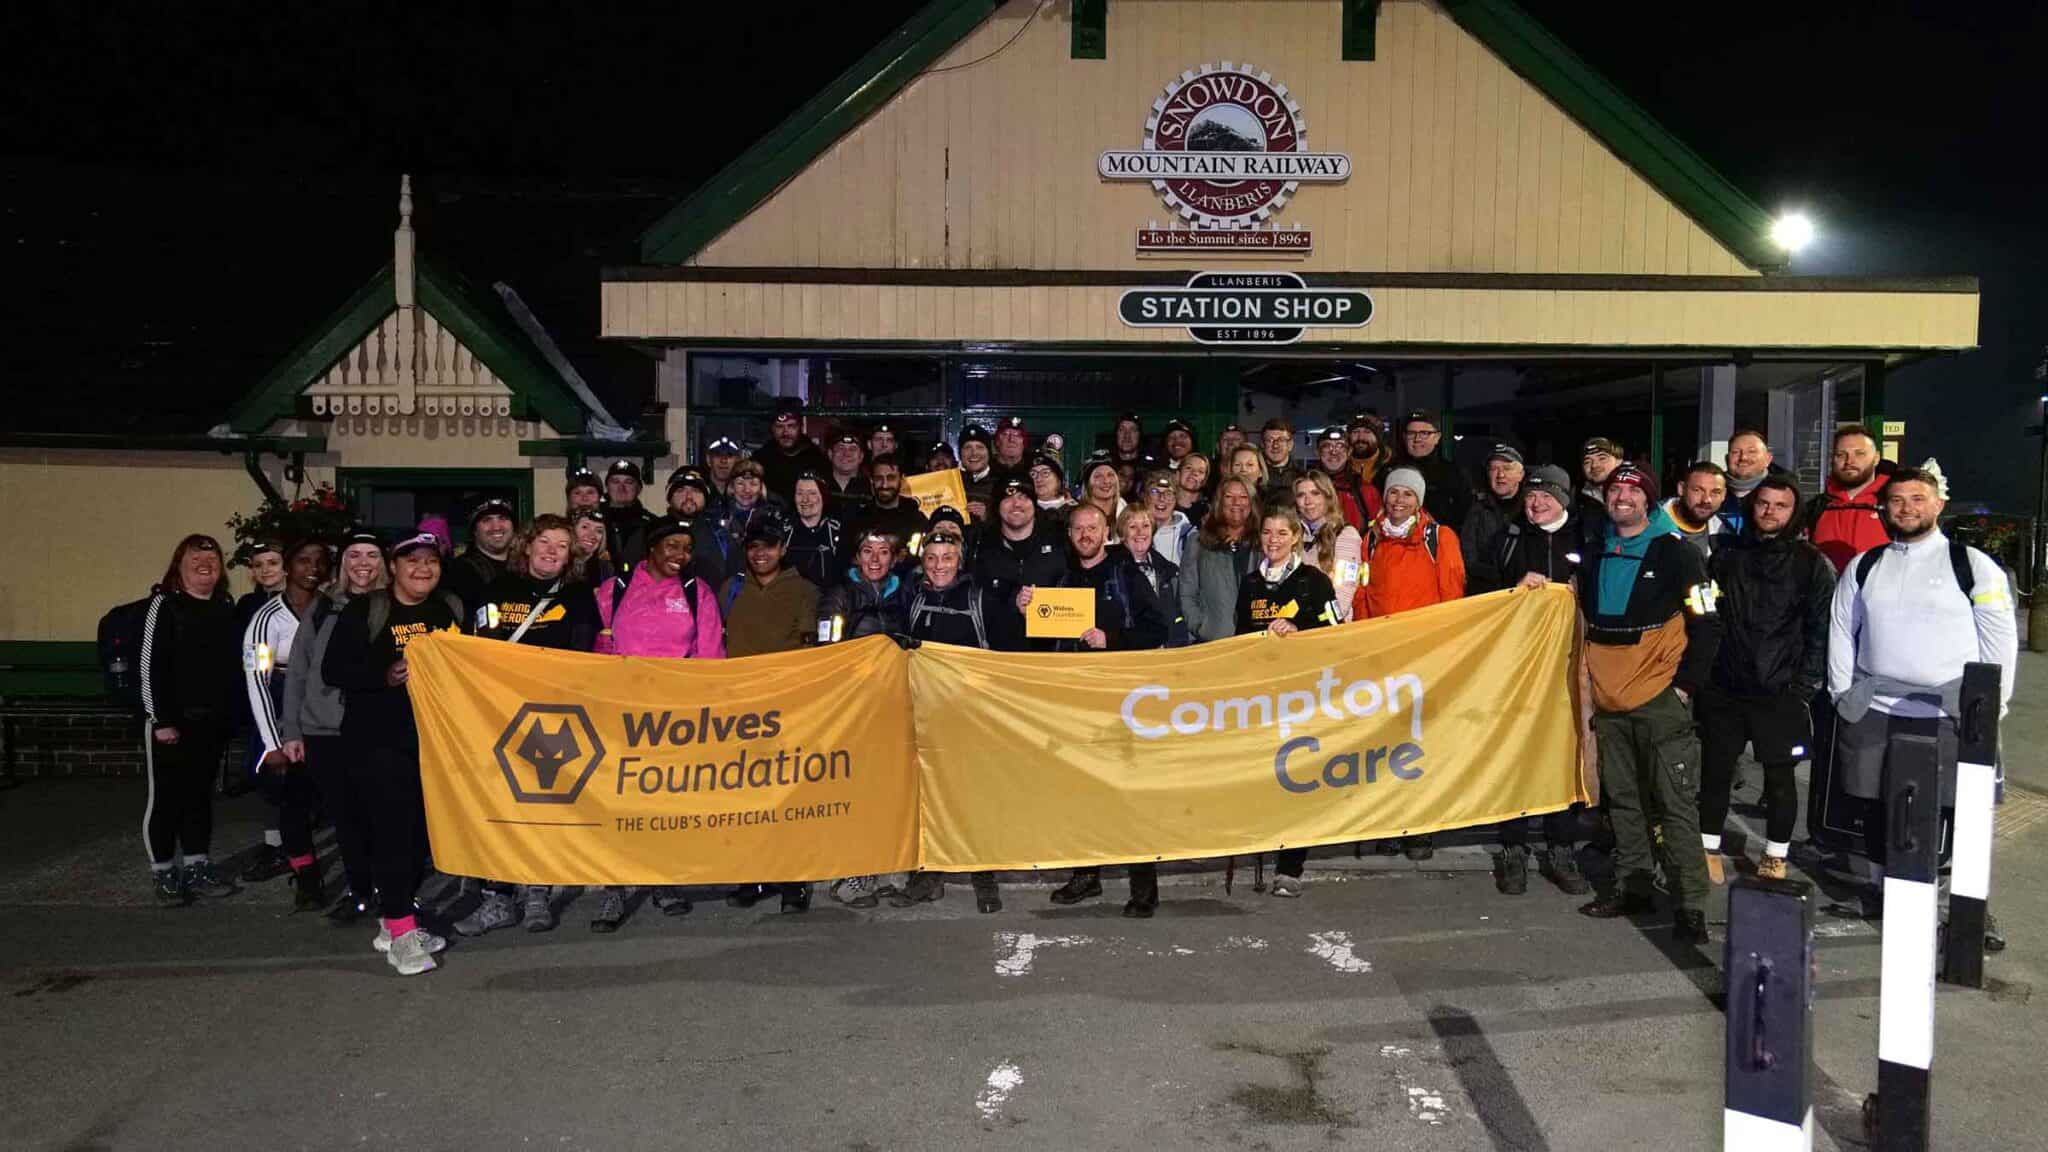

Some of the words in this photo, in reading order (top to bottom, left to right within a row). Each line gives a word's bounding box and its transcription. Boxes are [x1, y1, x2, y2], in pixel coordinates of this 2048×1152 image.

[1160, 76, 1293, 140] SNOWDON
[1107, 156, 1236, 174] MOUNTAIN
[1244, 157, 1342, 176] RAILWAY
[1179, 181, 1273, 211] LLANBERIS
[1148, 232, 1163, 244] To
[1167, 232, 1186, 244] the
[1189, 232, 1235, 244] Summit
[1238, 232, 1268, 245] since
[1273, 232, 1301, 244] 1896
[1211, 276, 1282, 287] LLANBERIS
[1141, 297, 1261, 318] STATION
[1273, 298, 1352, 318] SHOP
[1217, 330, 1238, 339] EST
[1247, 330, 1275, 339] 1896
[1120, 666, 1424, 741] Compton
[622, 707, 781, 748] Wolves
[616, 748, 851, 795] Foundation
[1275, 736, 1425, 793] Care
[616, 816, 644, 832] THE
[650, 814, 701, 832] CLUB'S
[707, 808, 778, 828] OFFICIAL
[785, 802, 851, 823] CHARITY
